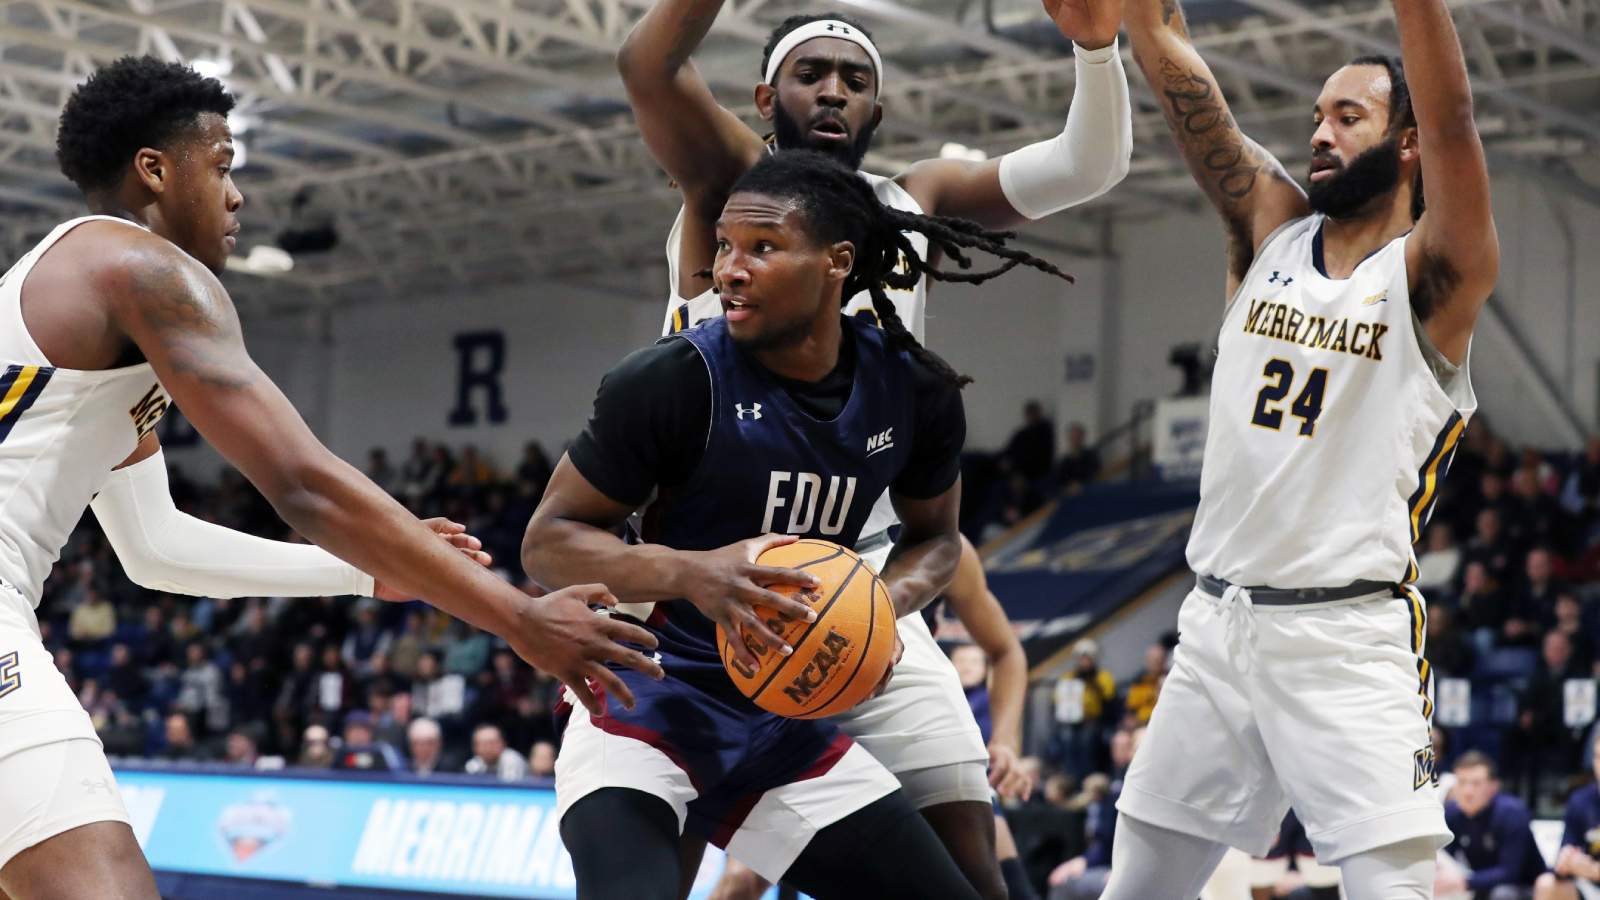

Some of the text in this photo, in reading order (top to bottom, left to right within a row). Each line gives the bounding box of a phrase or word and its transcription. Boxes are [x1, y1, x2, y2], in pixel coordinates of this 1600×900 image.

[1243, 298, 1389, 361] MERRIMACK
[450, 331, 508, 425] R
[1251, 357, 1330, 438] 24
[866, 427, 893, 452] NEC
[761, 471, 857, 535] FDU
[782, 630, 851, 705] NCAA
[825, 664, 843, 685] GAME
